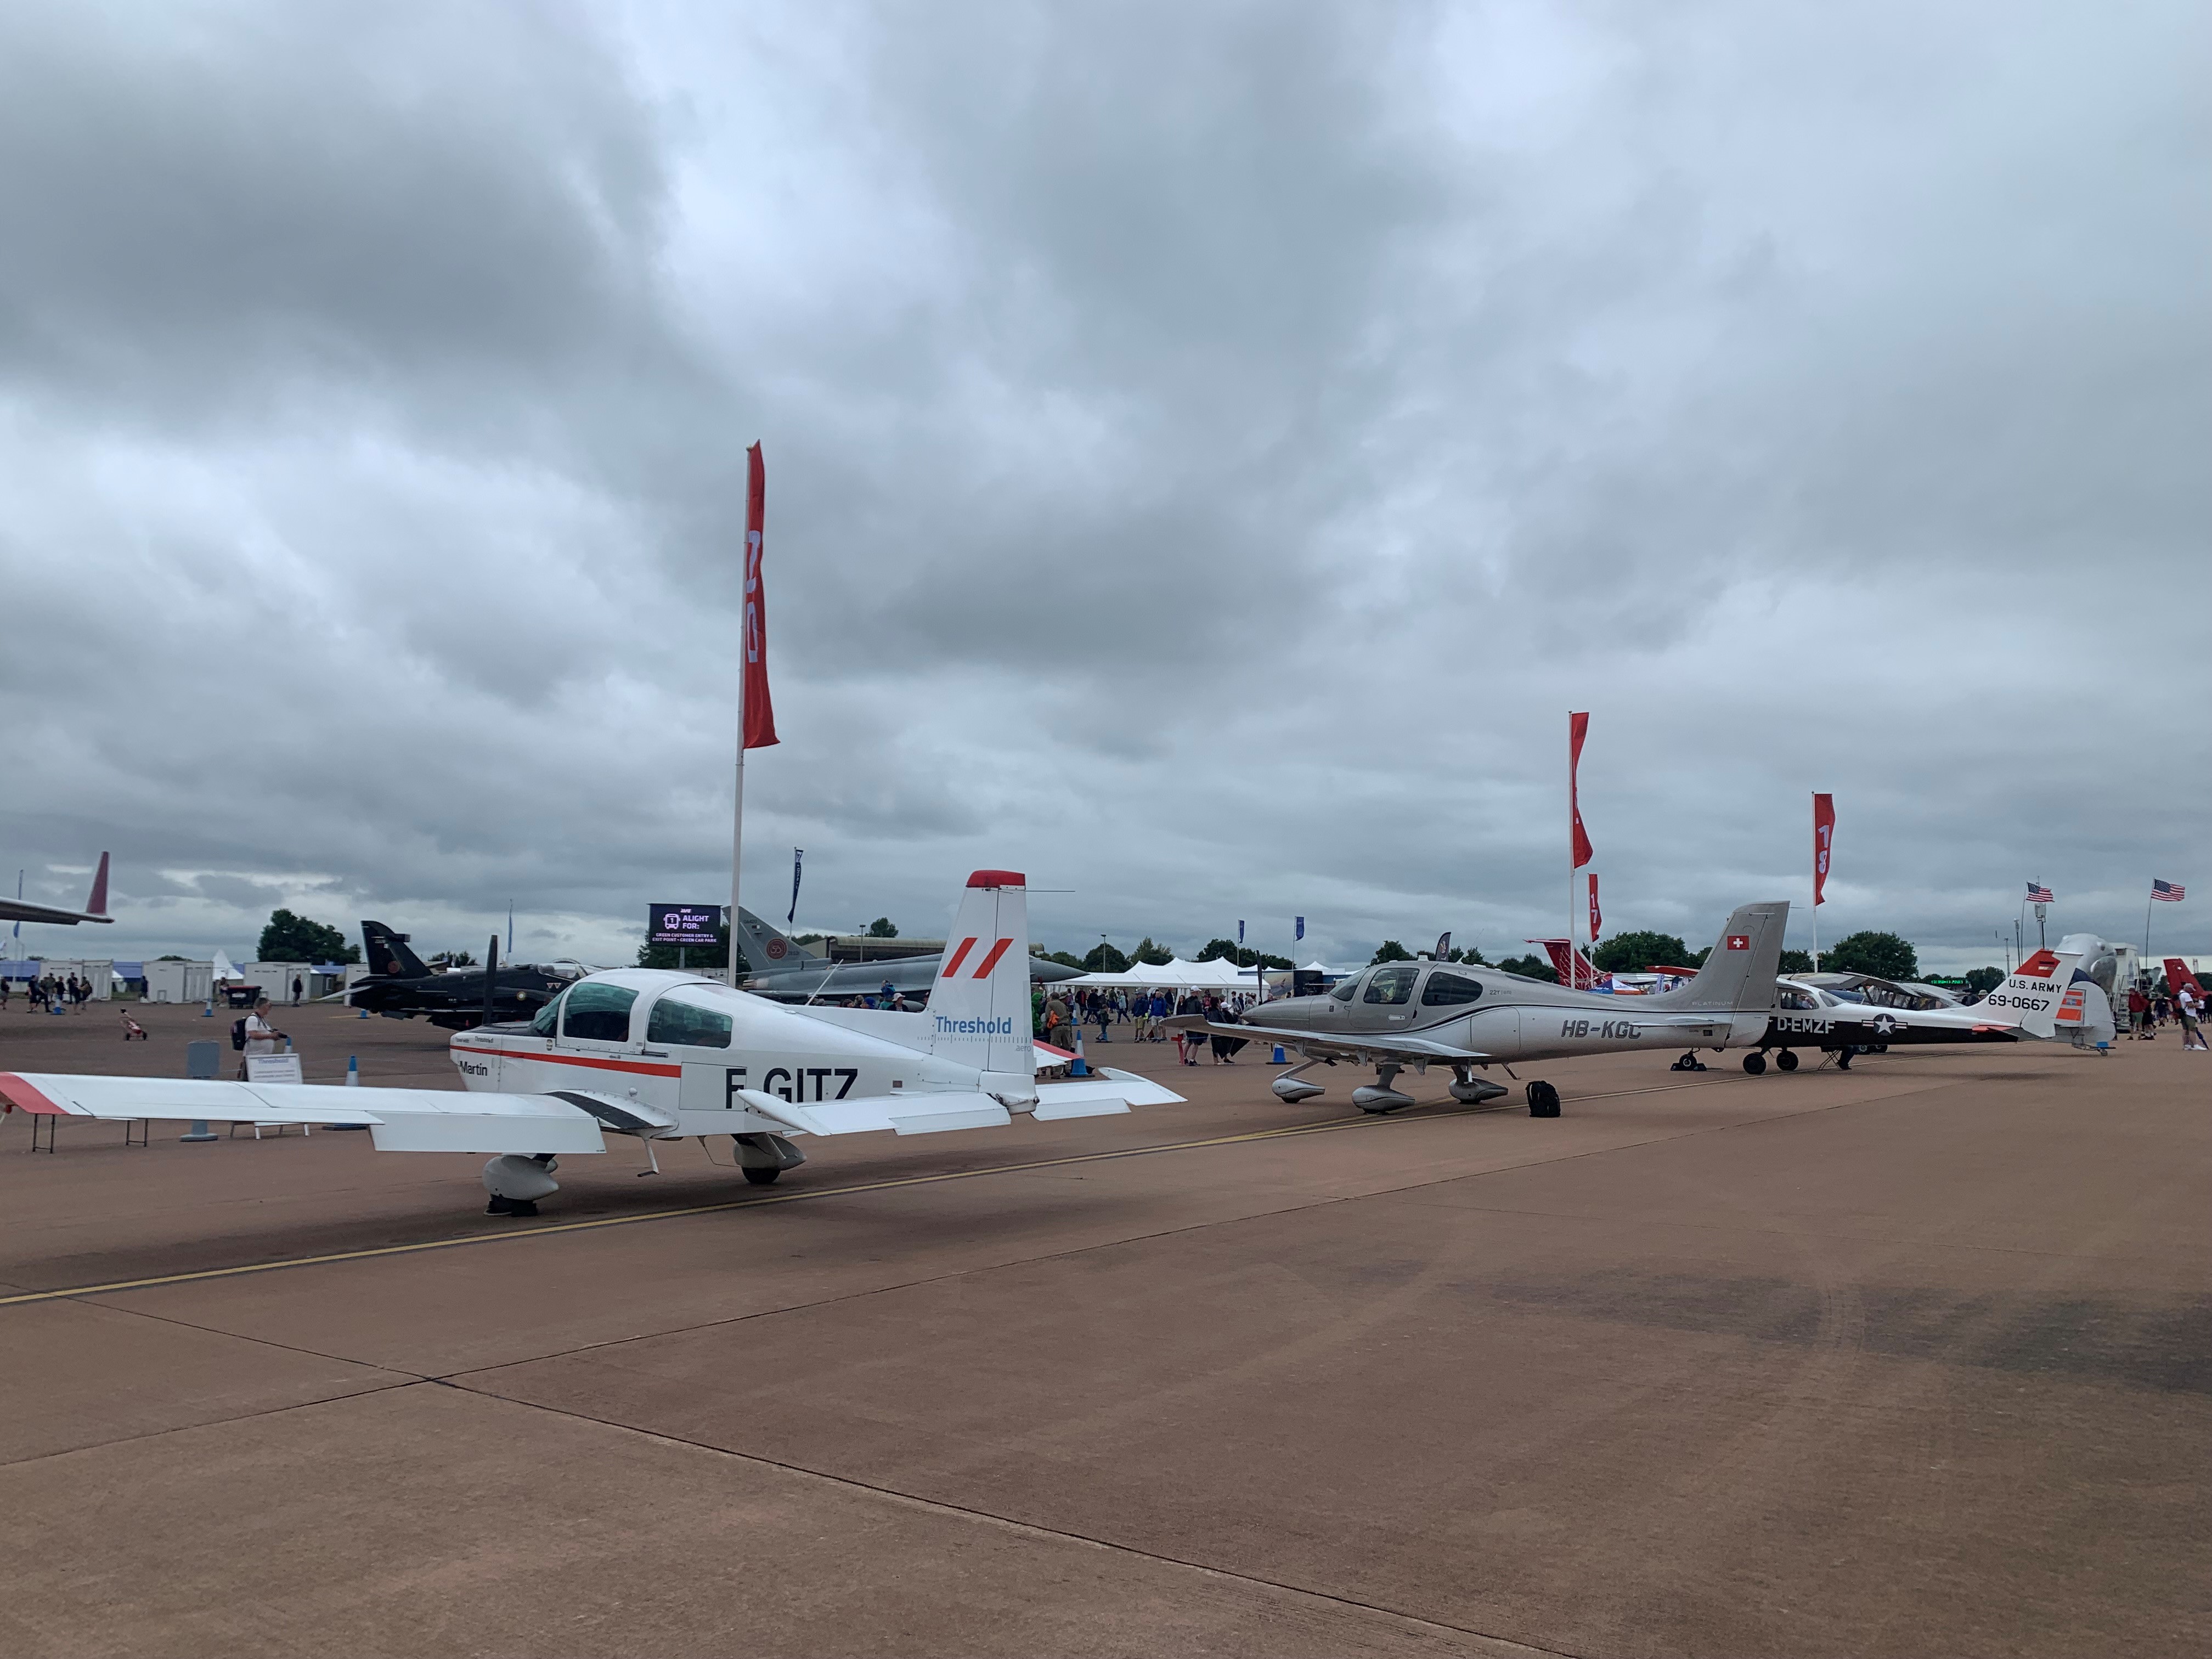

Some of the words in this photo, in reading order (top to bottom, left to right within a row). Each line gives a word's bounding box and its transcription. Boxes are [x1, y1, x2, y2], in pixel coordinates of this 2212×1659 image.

[1818, 825, 1829, 873] 18
[1590, 893, 1599, 924] 17
[2009, 979, 2028, 990] U.S.
[2031, 981, 2062, 994] ARMY
[1988, 994, 2050, 1012] 69-0667
[935, 1015, 1012, 1034] Threshold
[1561, 1020, 1641, 1039] HB-KGC
[1776, 1016, 1836, 1035] D-EMZF
[459, 1060, 488, 1076] Martin
